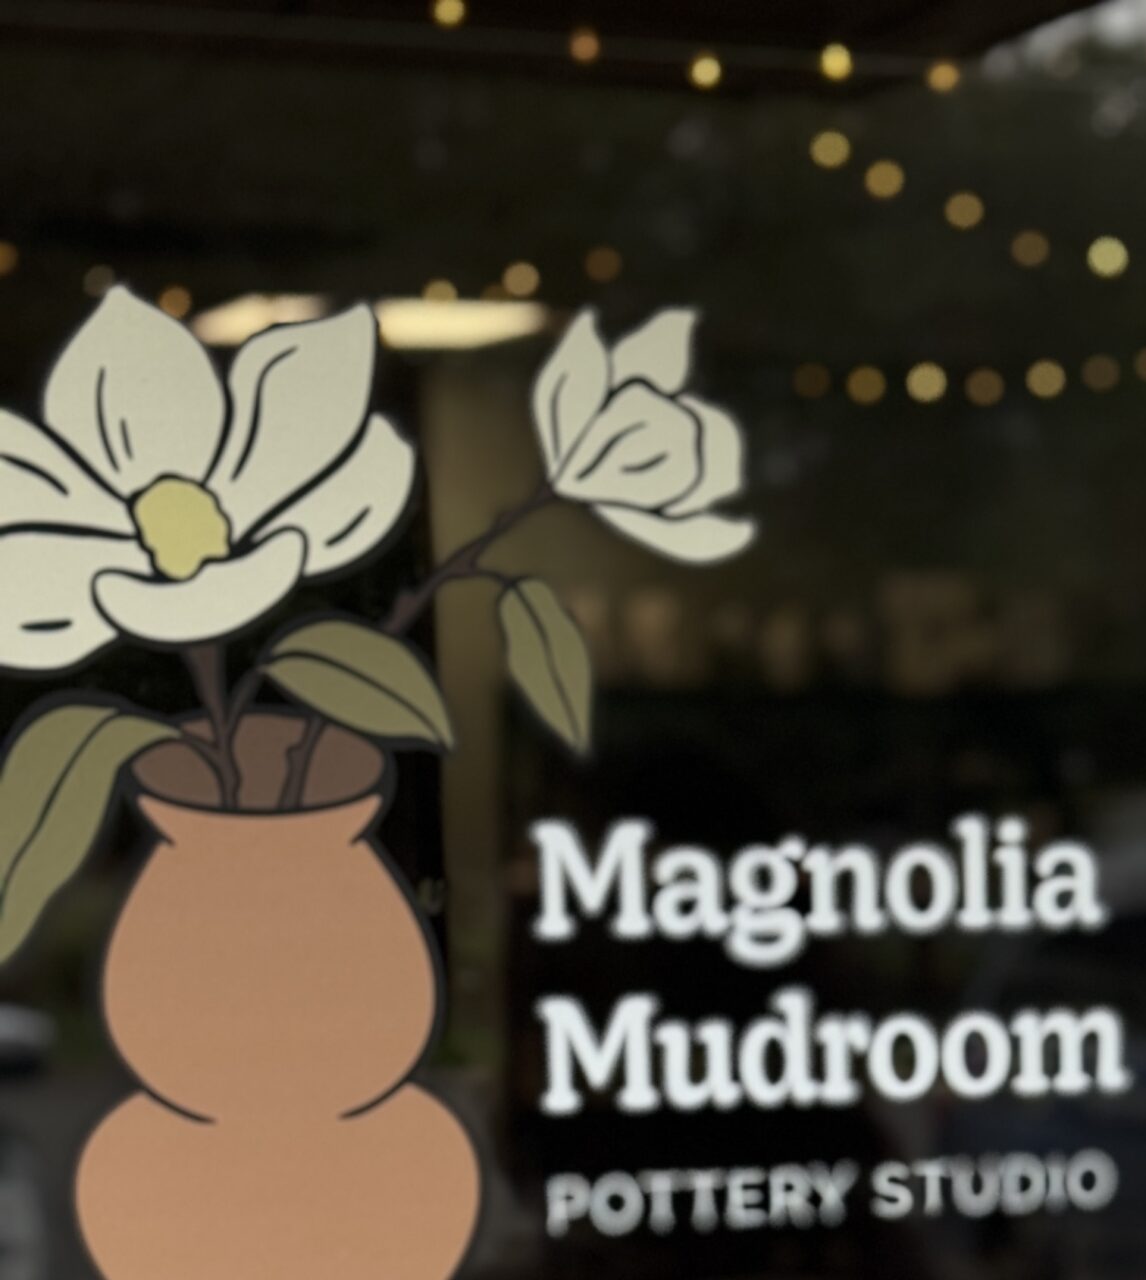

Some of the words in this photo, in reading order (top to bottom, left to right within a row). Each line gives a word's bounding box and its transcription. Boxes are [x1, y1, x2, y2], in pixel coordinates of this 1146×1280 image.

[532, 815, 1108, 968] Magnolia
[538, 987, 1132, 1115] Mudroom
[546, 1159, 857, 1235] POTTERY
[871, 1149, 1117, 1219] STUDIO
